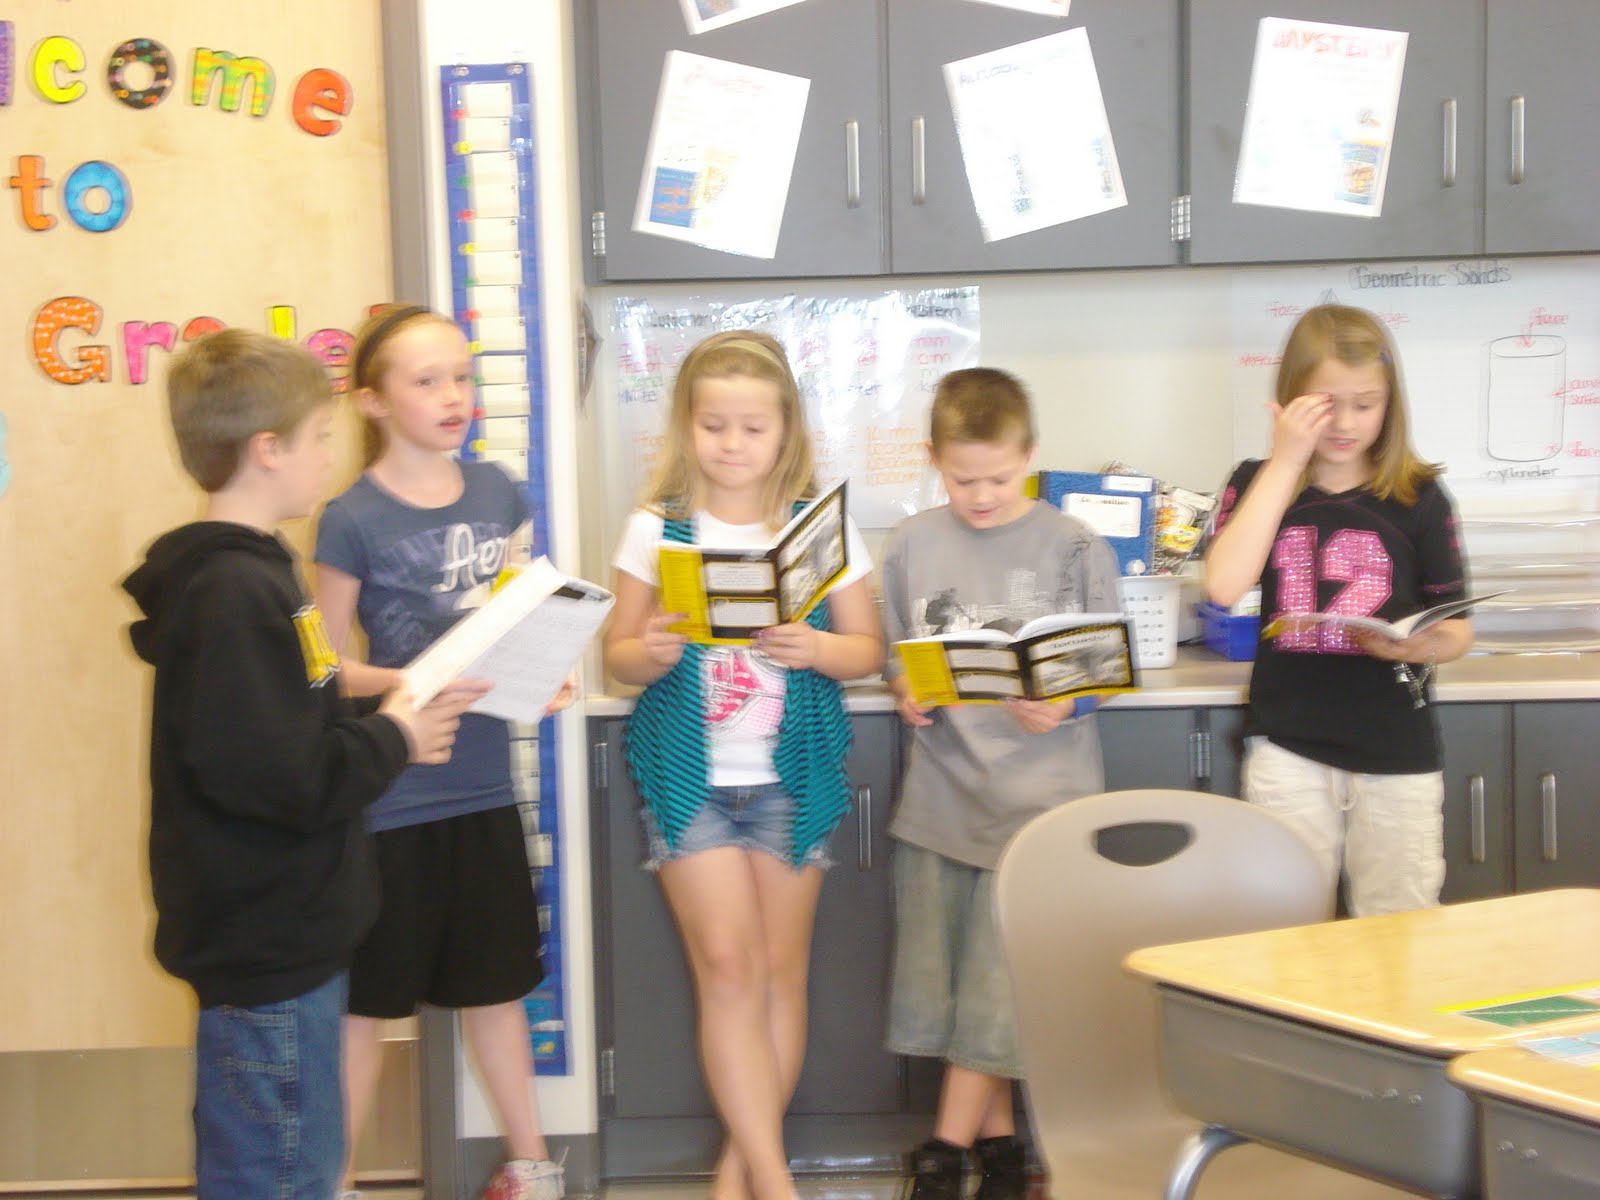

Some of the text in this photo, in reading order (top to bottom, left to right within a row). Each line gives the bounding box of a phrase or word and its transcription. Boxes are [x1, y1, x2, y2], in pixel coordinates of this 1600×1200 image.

[9, 155, 131, 232] to
[1350, 260, 1512, 289] Geometric Solids
[1487, 464, 1560, 484] cylinder
[1271, 525, 1394, 656] 12
